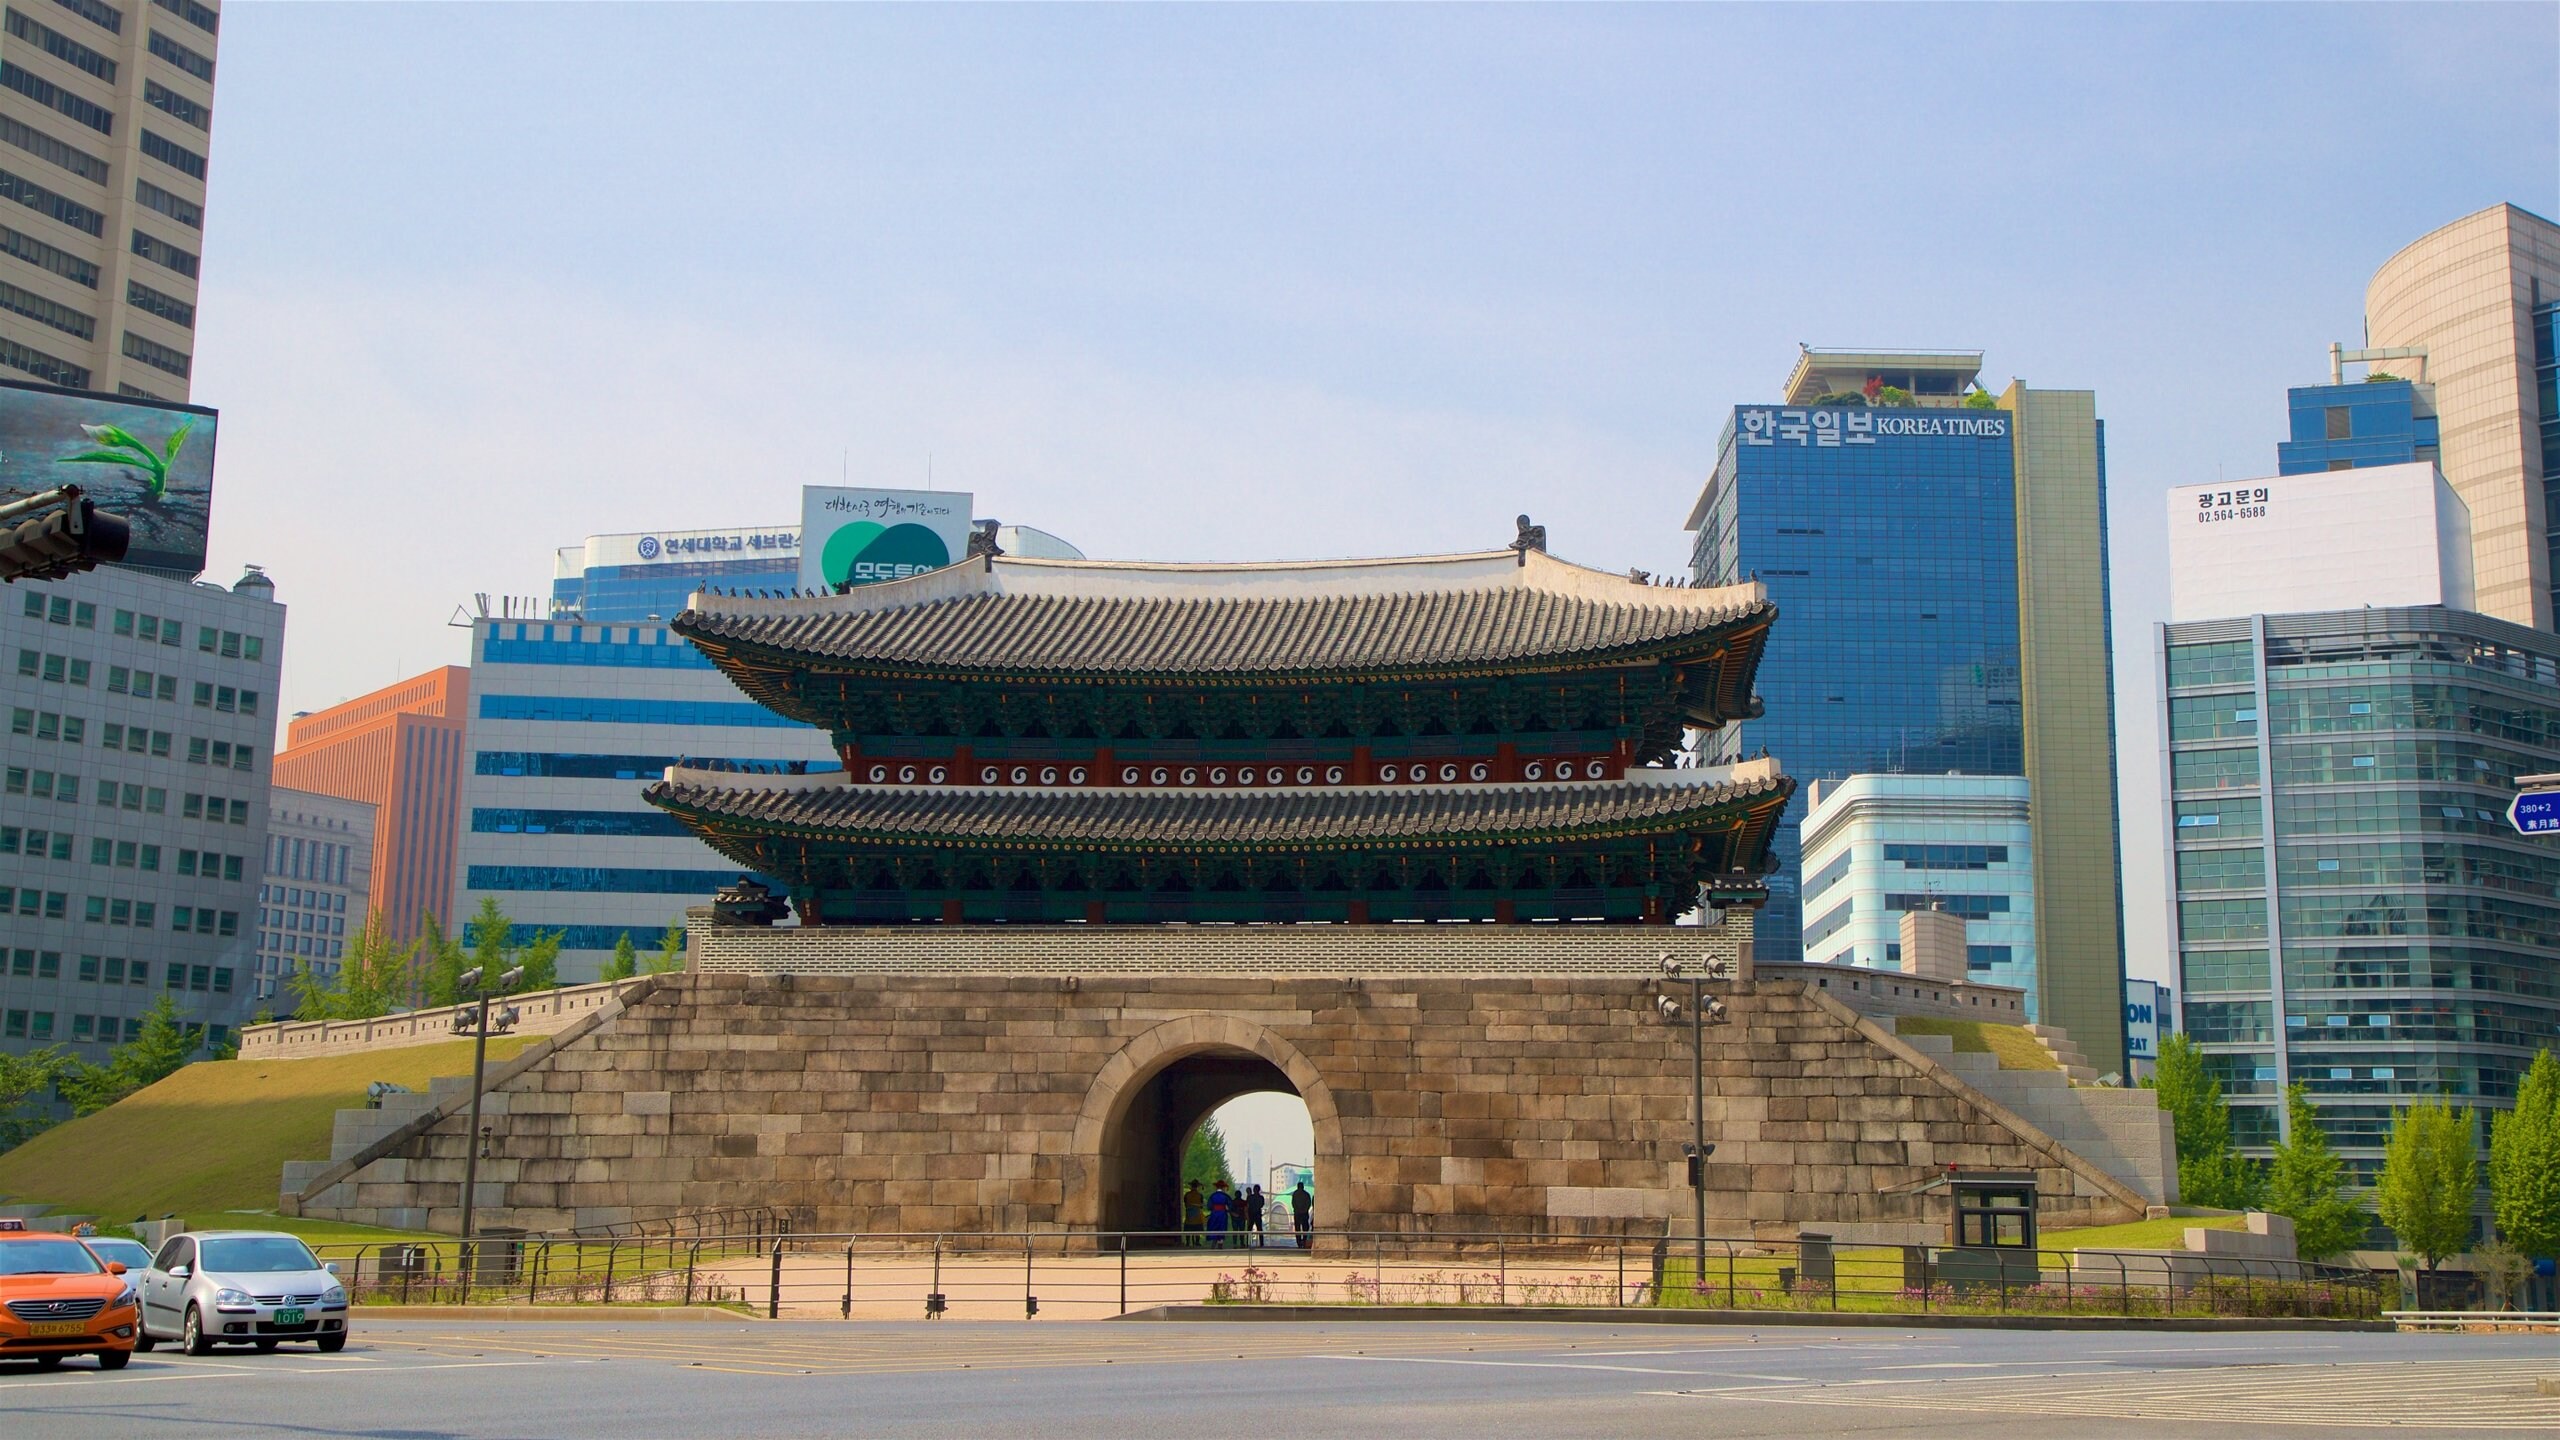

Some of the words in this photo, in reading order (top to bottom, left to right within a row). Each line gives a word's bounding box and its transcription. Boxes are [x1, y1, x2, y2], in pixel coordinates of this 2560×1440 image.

[1743, 410, 1876, 447] 한국일보
[1876, 418, 1944, 435] KOREA
[1945, 419, 2005, 436] TIMES
[825, 496, 870, 517] 대한민국
[2199, 488, 2269, 509] 광고문의
[2198, 506, 2266, 523] 02.564-6588
[664, 537, 743, 555] 연세대학교
[2520, 804, 2538, 814] 380
[2545, 803, 2552, 812] 2
[277, 1313, 304, 1324] 1019
